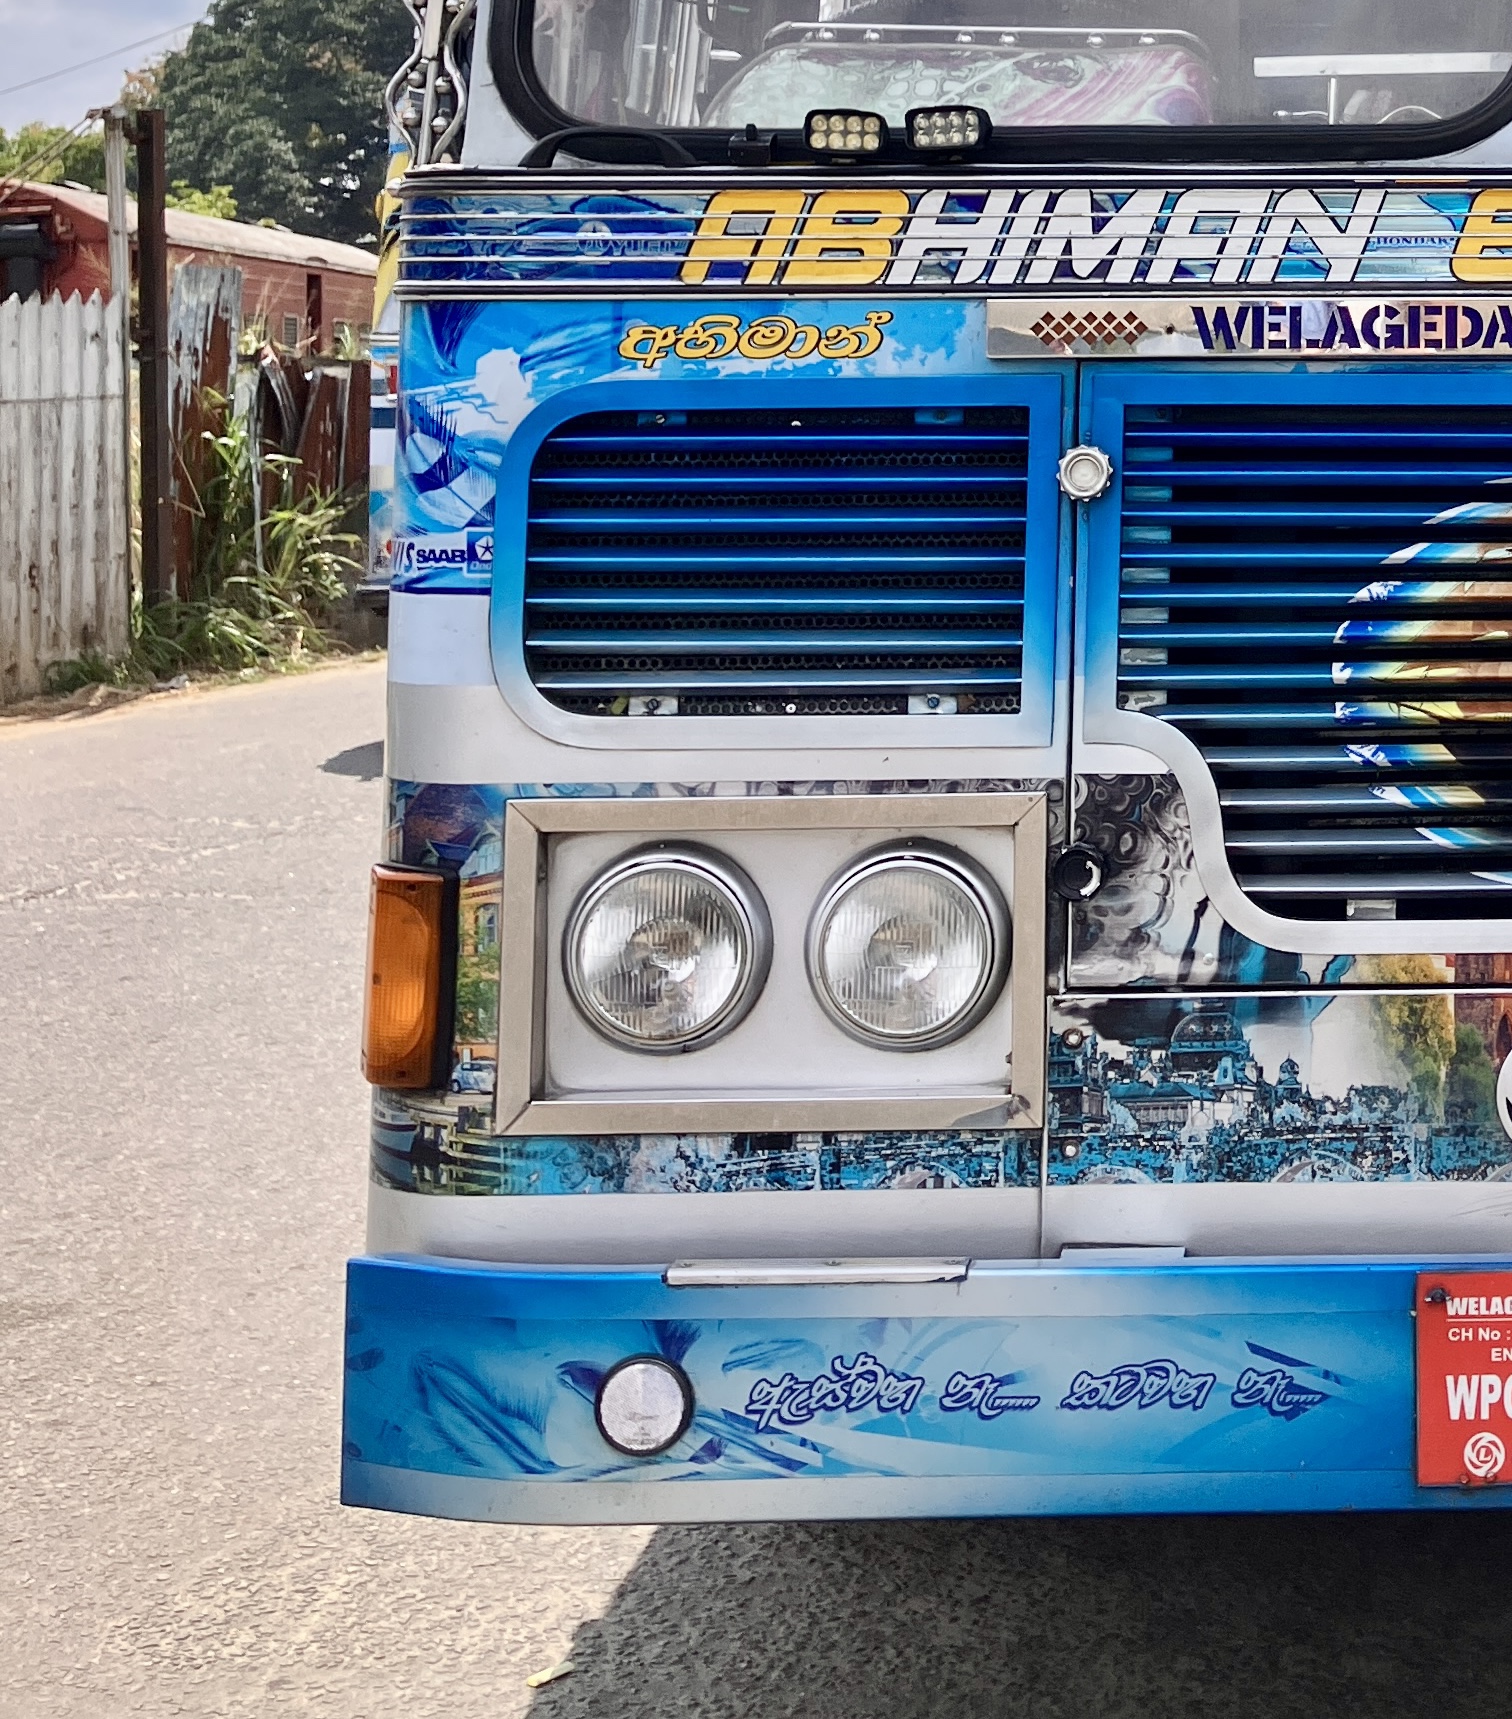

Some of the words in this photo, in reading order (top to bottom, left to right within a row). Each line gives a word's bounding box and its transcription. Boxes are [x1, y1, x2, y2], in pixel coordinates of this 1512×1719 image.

[618, 310, 894, 368] අභිමාන්
[1448, 1328, 1474, 1342] CH
[1477, 1328, 1501, 1342] No
